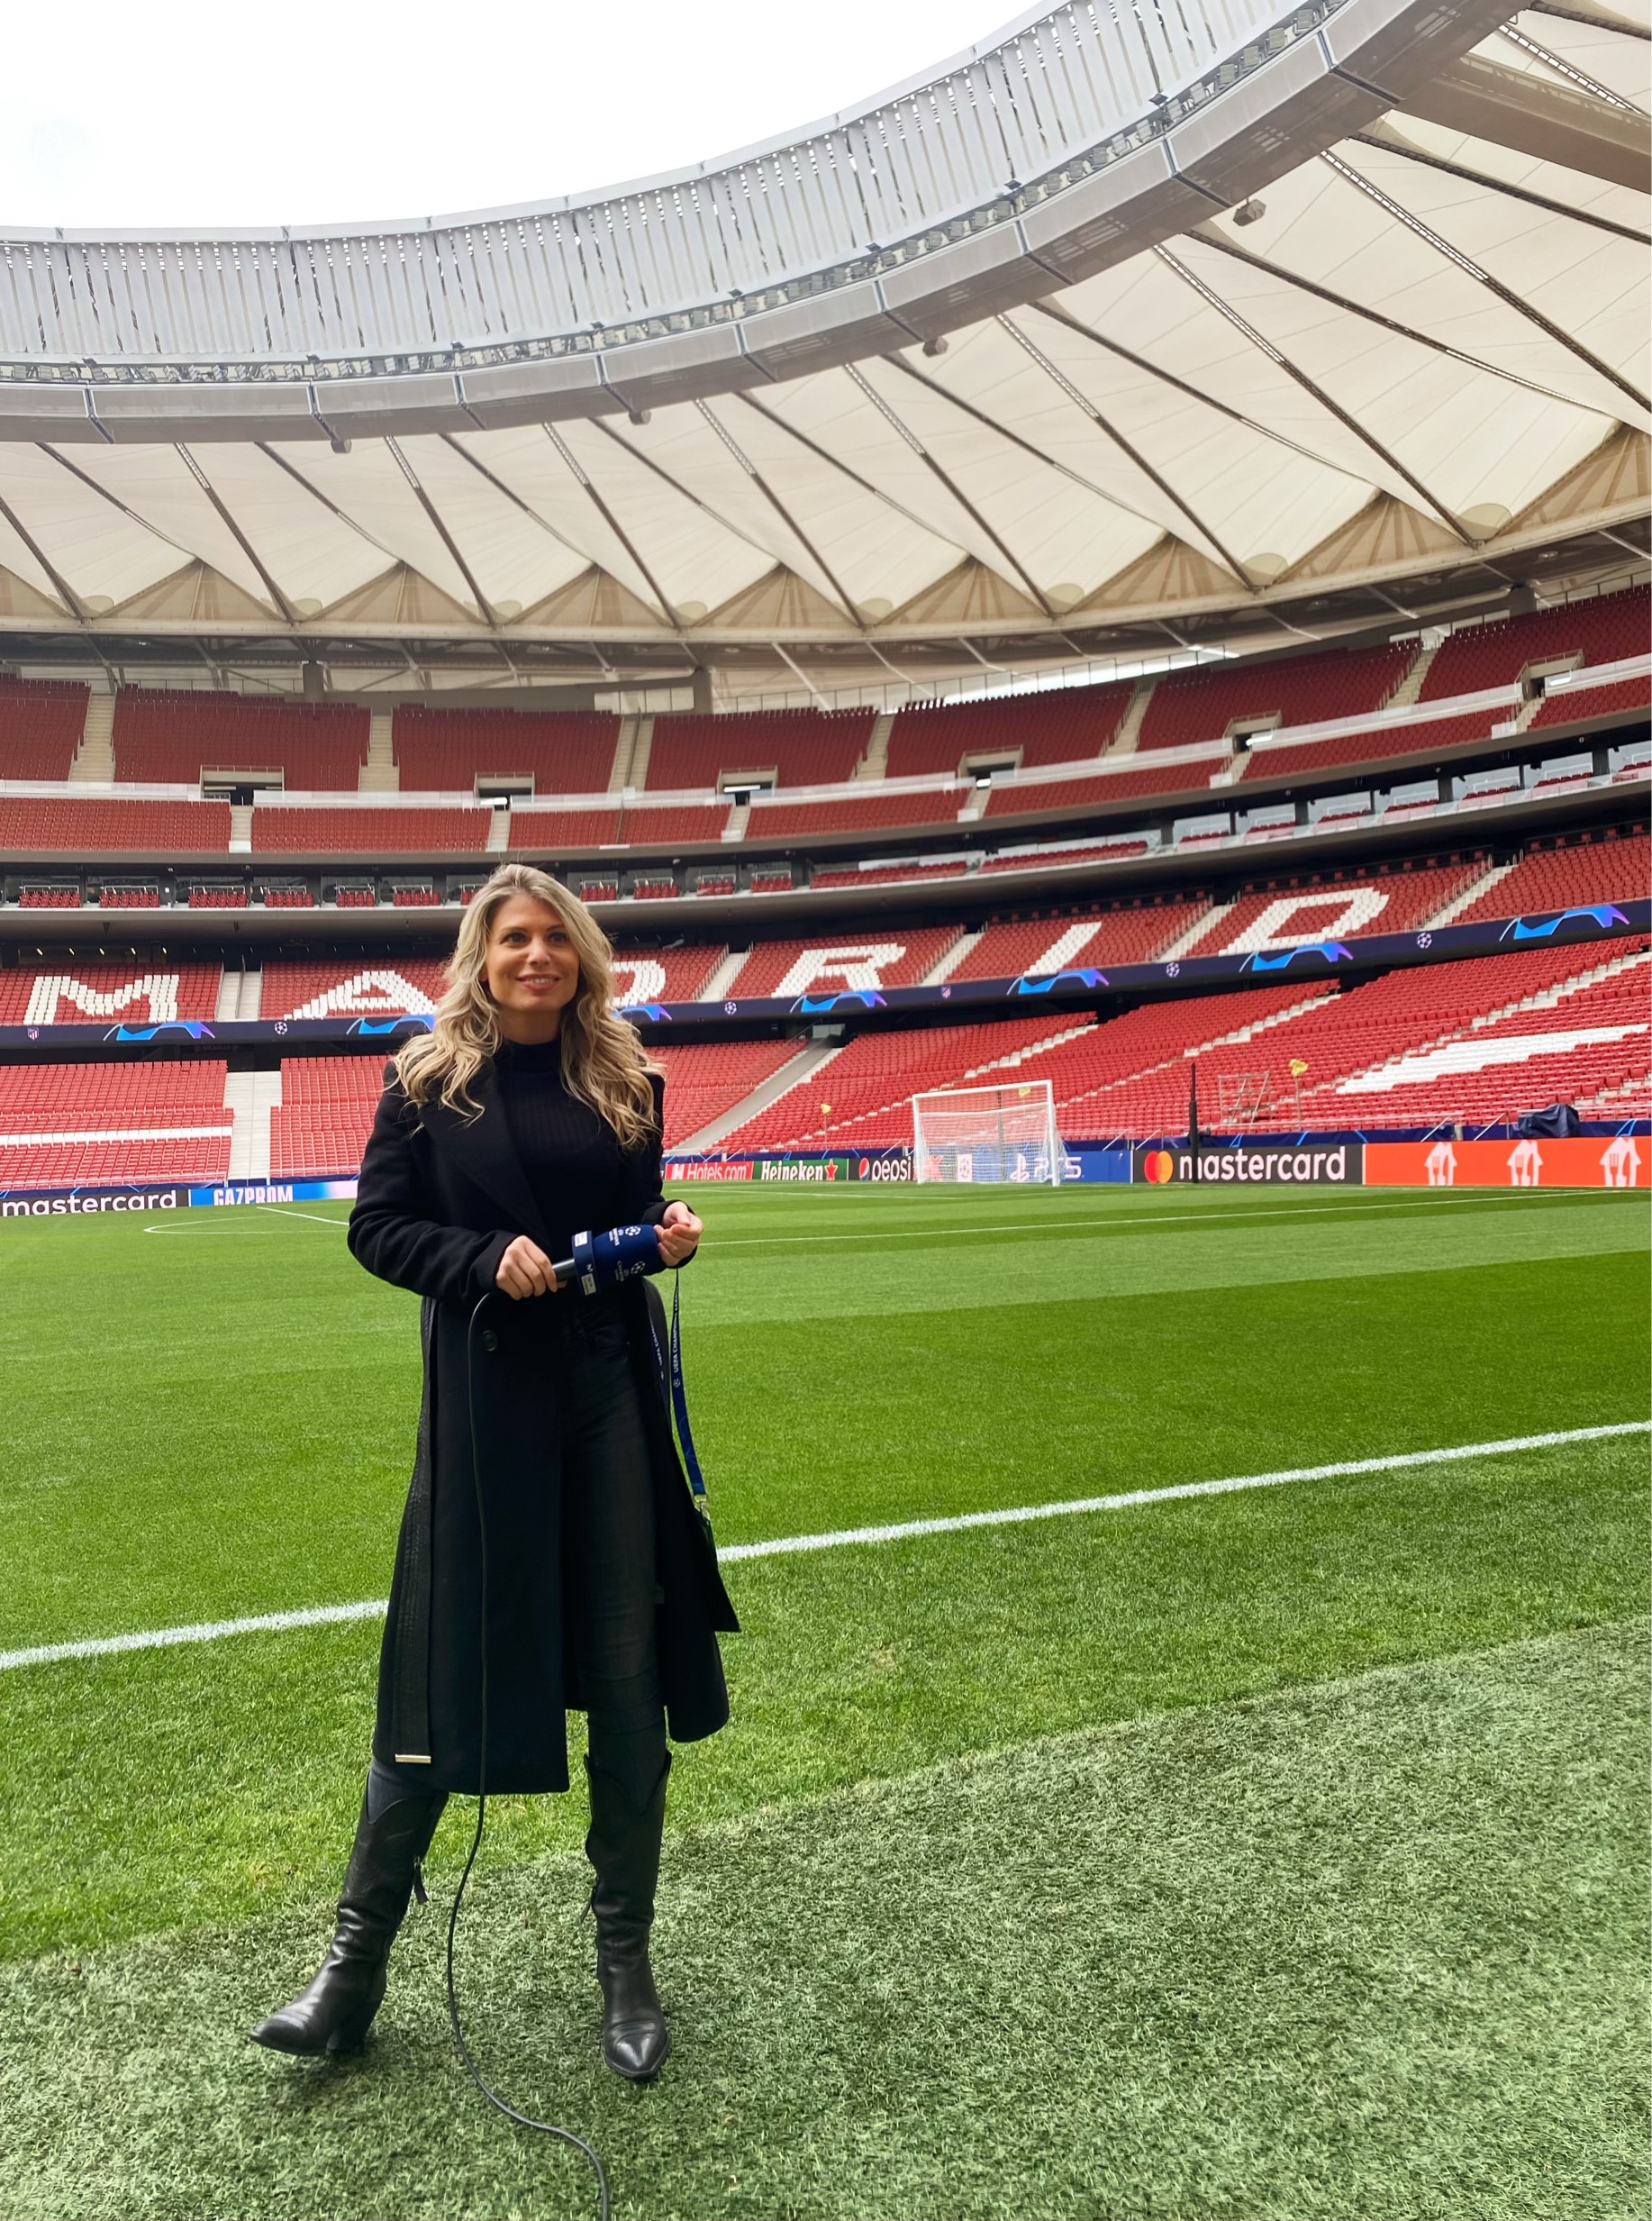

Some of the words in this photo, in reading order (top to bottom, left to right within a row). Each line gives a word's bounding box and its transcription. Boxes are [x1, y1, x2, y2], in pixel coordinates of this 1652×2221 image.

[687, 1161, 747, 1180] Hotels.com
[761, 1160, 823, 1180] Heineken
[872, 1156, 912, 1180] pepsi
[1179, 1145, 1346, 1181] mastercard
[2, 1190, 177, 1216] mastercard
[213, 1185, 294, 1206] GAZPROM
